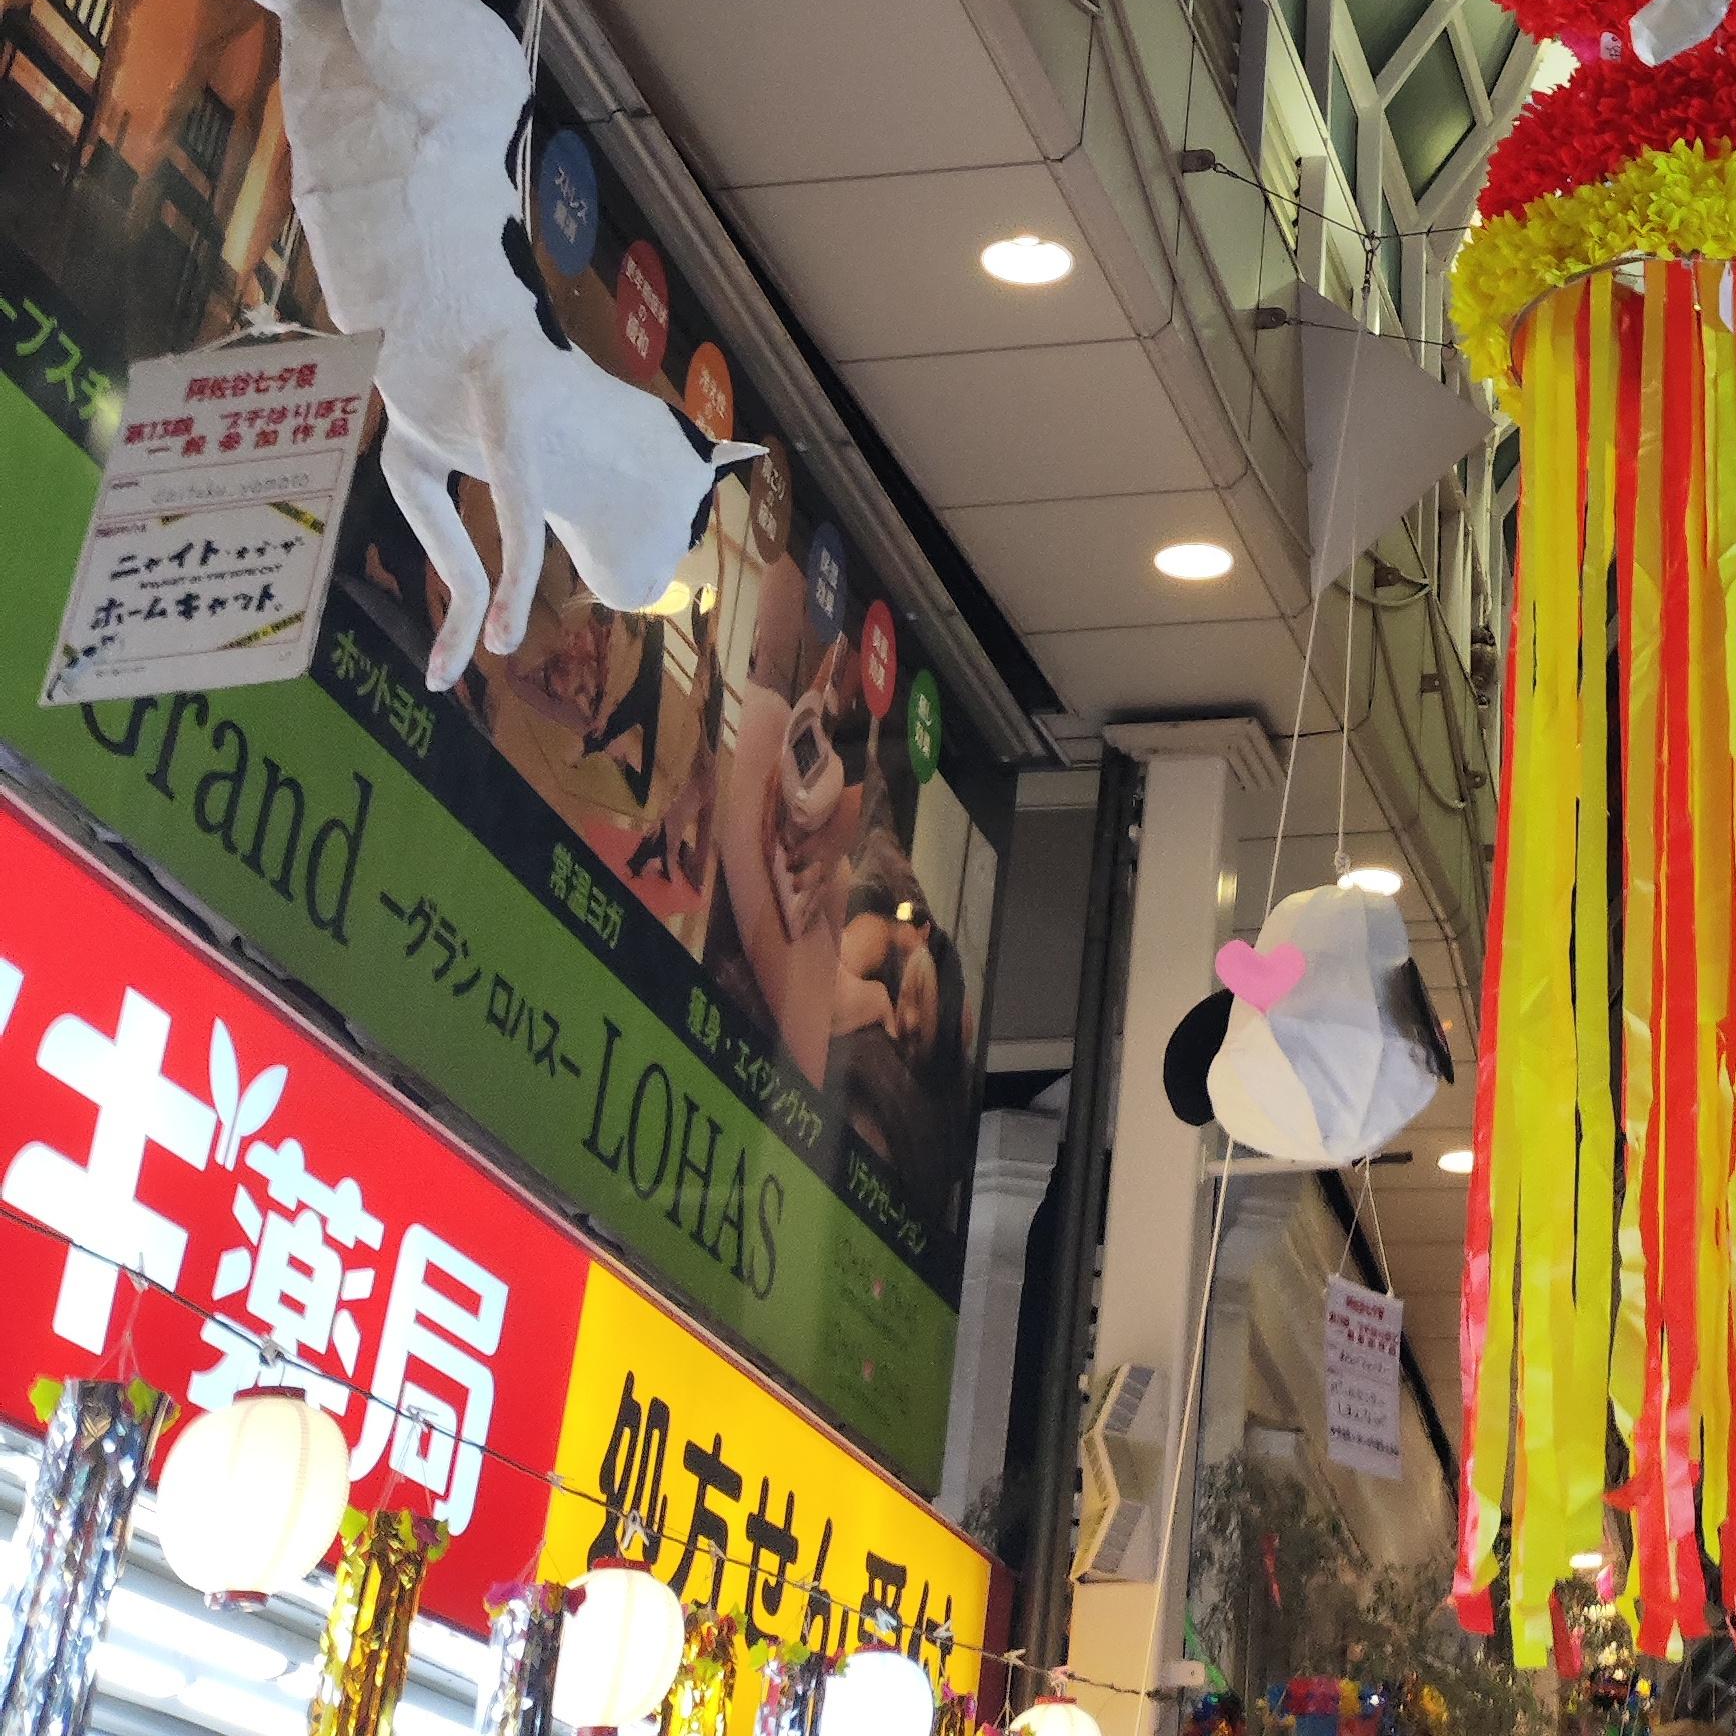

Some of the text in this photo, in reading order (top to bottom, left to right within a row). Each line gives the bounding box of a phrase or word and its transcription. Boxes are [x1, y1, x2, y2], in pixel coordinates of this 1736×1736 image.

[330, 629, 437, 758] ホットヨガ
[547, 843, 626, 951] 常温ヨガ
[0, 954, 510, 1537] ギ薬局
[581, 1014, 787, 1302] LOHAS
